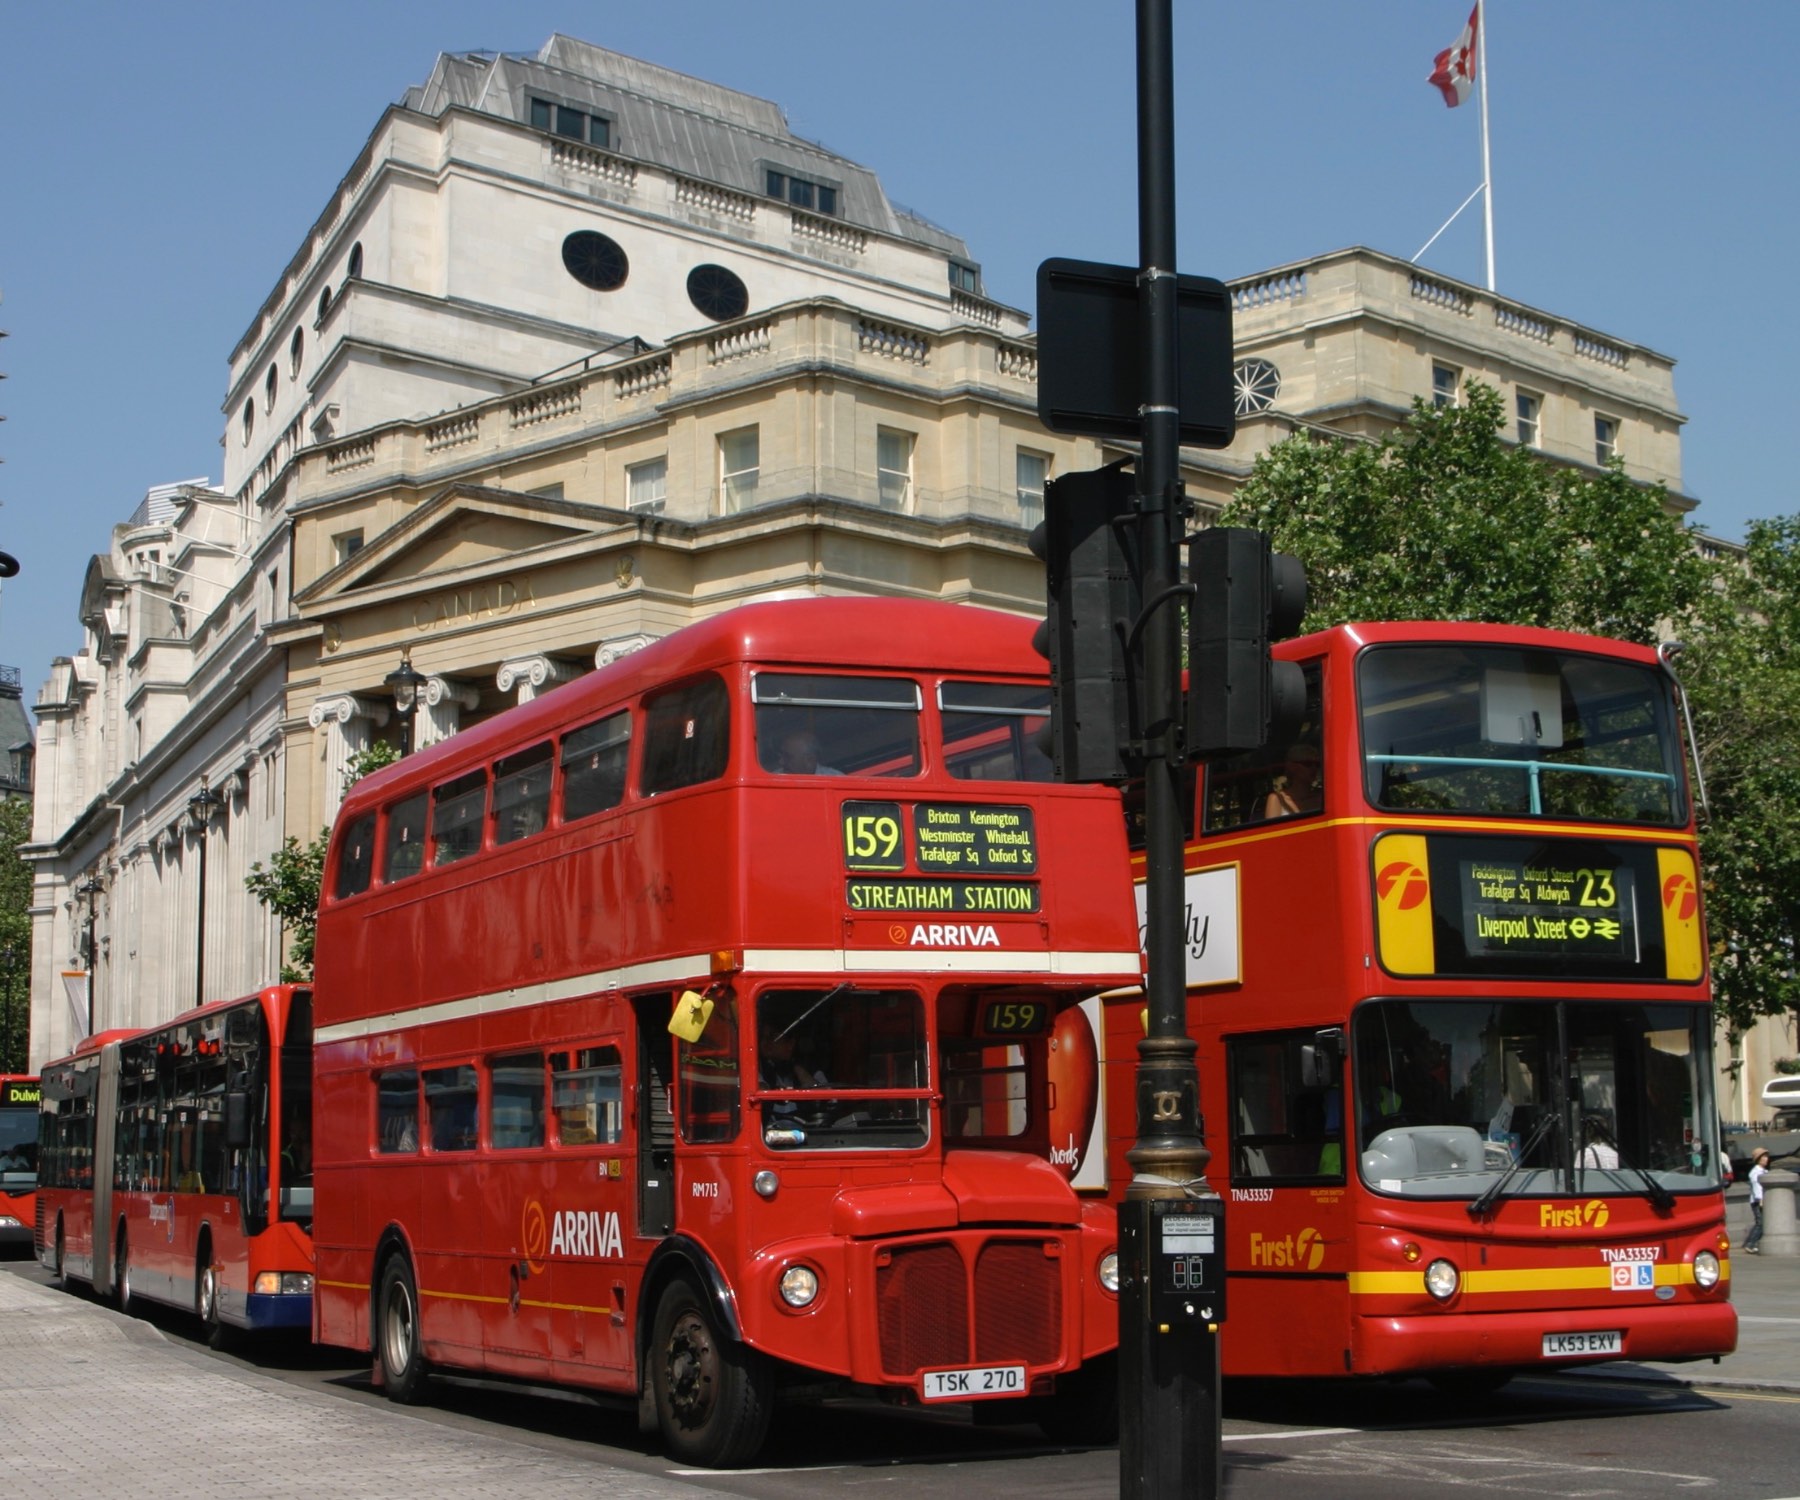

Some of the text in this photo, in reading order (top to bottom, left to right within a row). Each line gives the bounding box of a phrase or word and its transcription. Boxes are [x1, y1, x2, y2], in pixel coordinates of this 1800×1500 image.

[413, 575, 536, 632] CANADA
[928, 809, 1019, 828] Brixton Kennington
[846, 816, 899, 858] 159
[919, 828, 1030, 845] Westminster Whitehall
[919, 847, 1033, 865] Trafalgar Sq Oxford St
[1551, 867, 1575, 883] Street
[851, 885, 1032, 910] STREATHAM STATION
[1480, 882, 1570, 905] Trafalgar Sq Aldwych
[1576, 868, 1616, 908] 23
[910, 924, 1000, 946] ARRIVA
[1477, 913, 1568, 944] Liverpool Street
[992, 1004, 1035, 1028] 159
[10, 1089, 40, 1102] Dulwi
[692, 1182, 719, 1198] RM713
[1231, 1188, 1273, 1202] TNA33357
[1540, 1204, 1582, 1228] First
[550, 1210, 624, 1258] ARRIVA
[1250, 1232, 1294, 1268] First
[1600, 1247, 1660, 1262] TNA33357
[1548, 1335, 1585, 1353] LK53
[936, 1370, 1017, 1392] TSK 270
